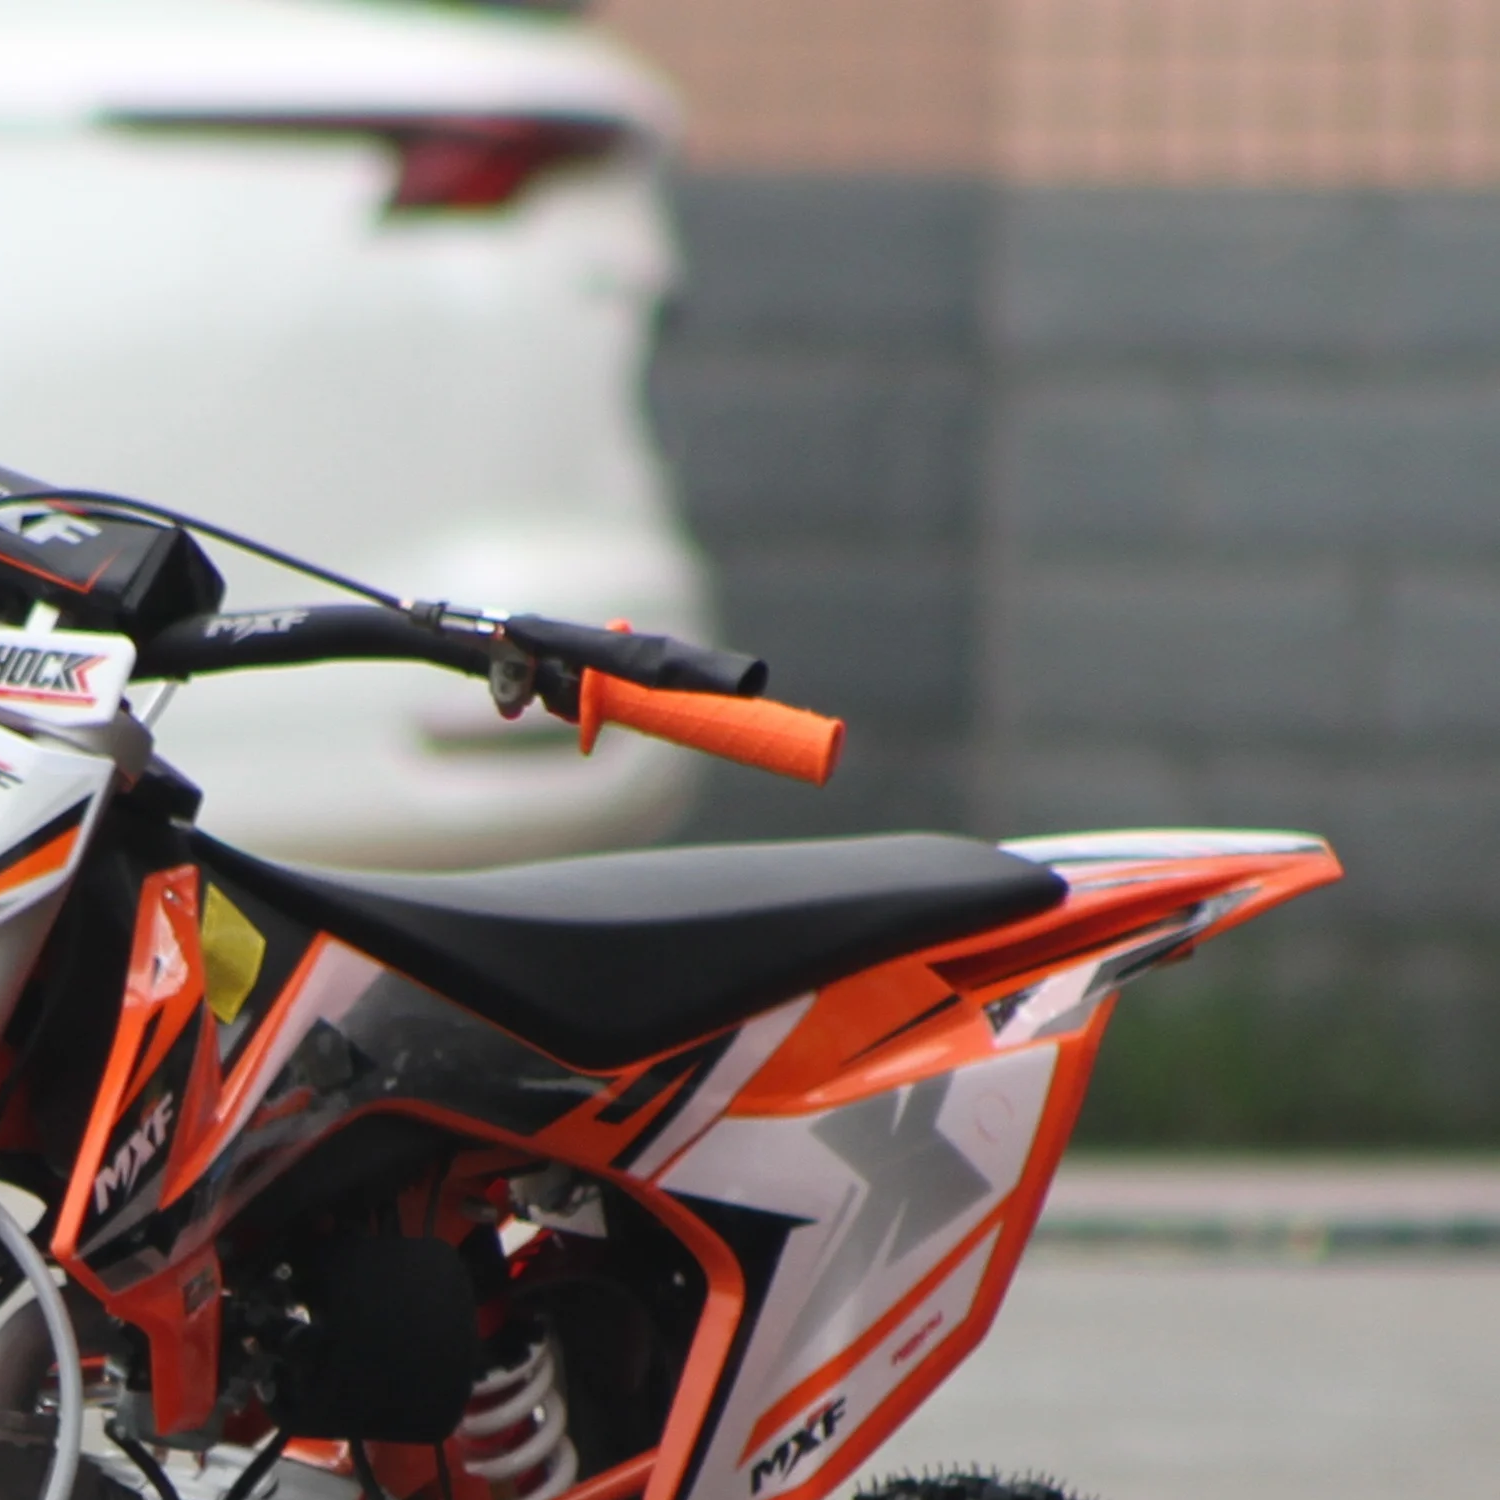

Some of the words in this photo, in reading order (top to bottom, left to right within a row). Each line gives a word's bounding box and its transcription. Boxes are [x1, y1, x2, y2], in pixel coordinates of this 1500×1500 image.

[204, 609, 310, 642] MXF
[95, 1090, 174, 1215] MXF
[751, 1396, 846, 1495] MXF
